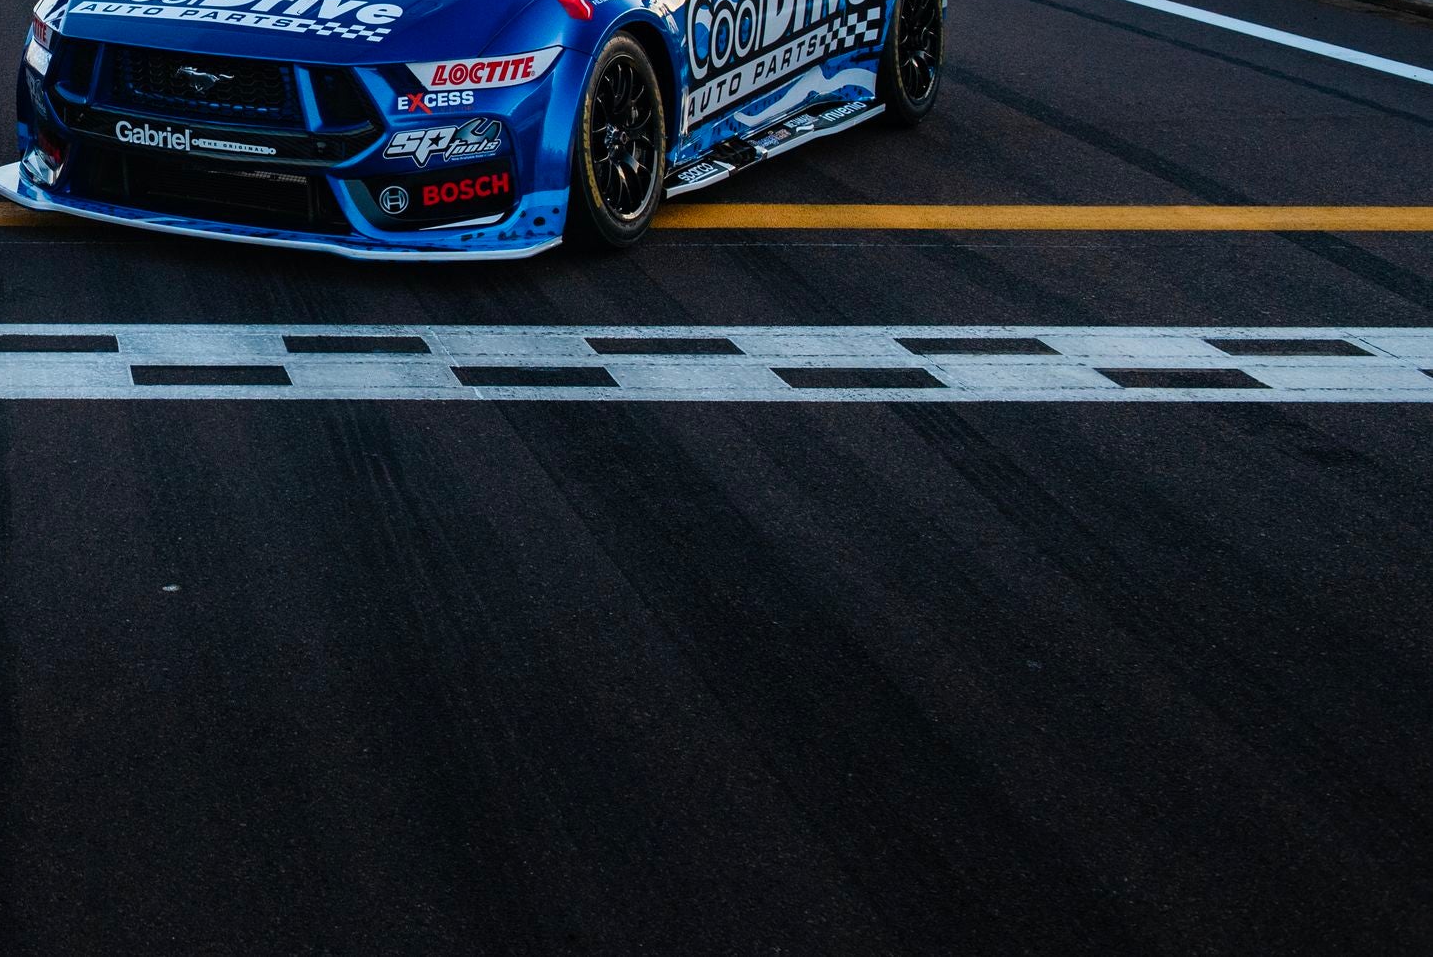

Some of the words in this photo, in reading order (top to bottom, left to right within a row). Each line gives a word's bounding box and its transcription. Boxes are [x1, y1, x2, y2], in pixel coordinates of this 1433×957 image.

[80, 2, 166, 16] AUTO
[179, 9, 292, 28] PARTS
[431, 56, 535, 86] LOCTITE
[687, 72, 742, 118] AUTO
[753, 37, 817, 85] PARTS
[397, 91, 475, 115] EXCESS
[821, 100, 866, 122] invenio
[116, 120, 191, 151] Gabriel
[386, 127, 457, 164] SP
[423, 172, 510, 207] BOSCH
